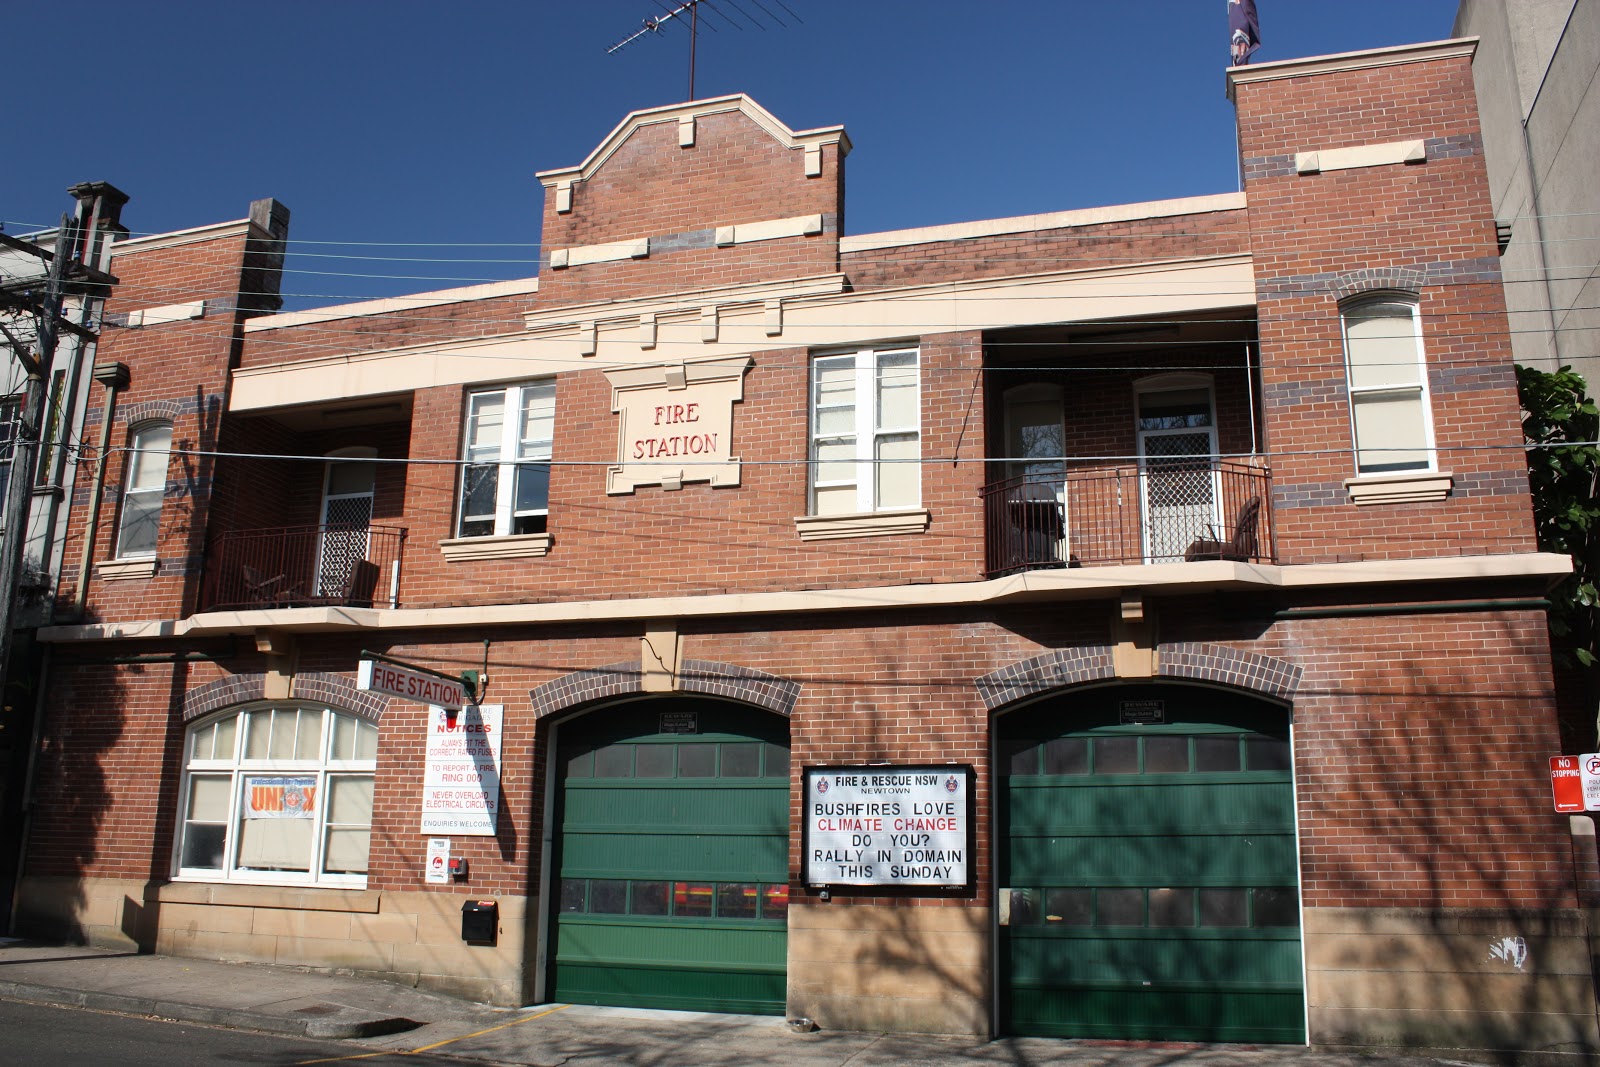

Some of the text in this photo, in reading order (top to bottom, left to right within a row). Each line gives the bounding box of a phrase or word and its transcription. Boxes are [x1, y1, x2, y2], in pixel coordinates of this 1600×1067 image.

[654, 403, 699, 426] FIRE
[633, 433, 718, 459] STATION
[372, 668, 462, 707] FIRE STATION
[437, 724, 492, 733] NOTICES
[464, 739, 473, 747] FIT
[475, 739, 486, 747] THE
[478, 748, 497, 756] FUSES
[432, 764, 495, 772] TO REPORT A FIRE
[1558, 759, 1571, 768] NO
[442, 773, 482, 783] RING 000
[1552, 769, 1580, 778] STOPPING
[836, 775, 938, 787] FIRE & RESCUE NSW
[432, 791, 489, 800] NEVER OVERLOAD
[426, 800, 495, 809] ELECTRICAL CIRCUITS
[815, 802, 955, 816] BUSHFIRES LOVE
[818, 818, 957, 831] CLIMATE CHANGE
[852, 834, 930, 847] DO YOU?
[814, 850, 962, 863] RALLY IN DOMAIN
[838, 865, 952, 878] THIS SUNDAY
